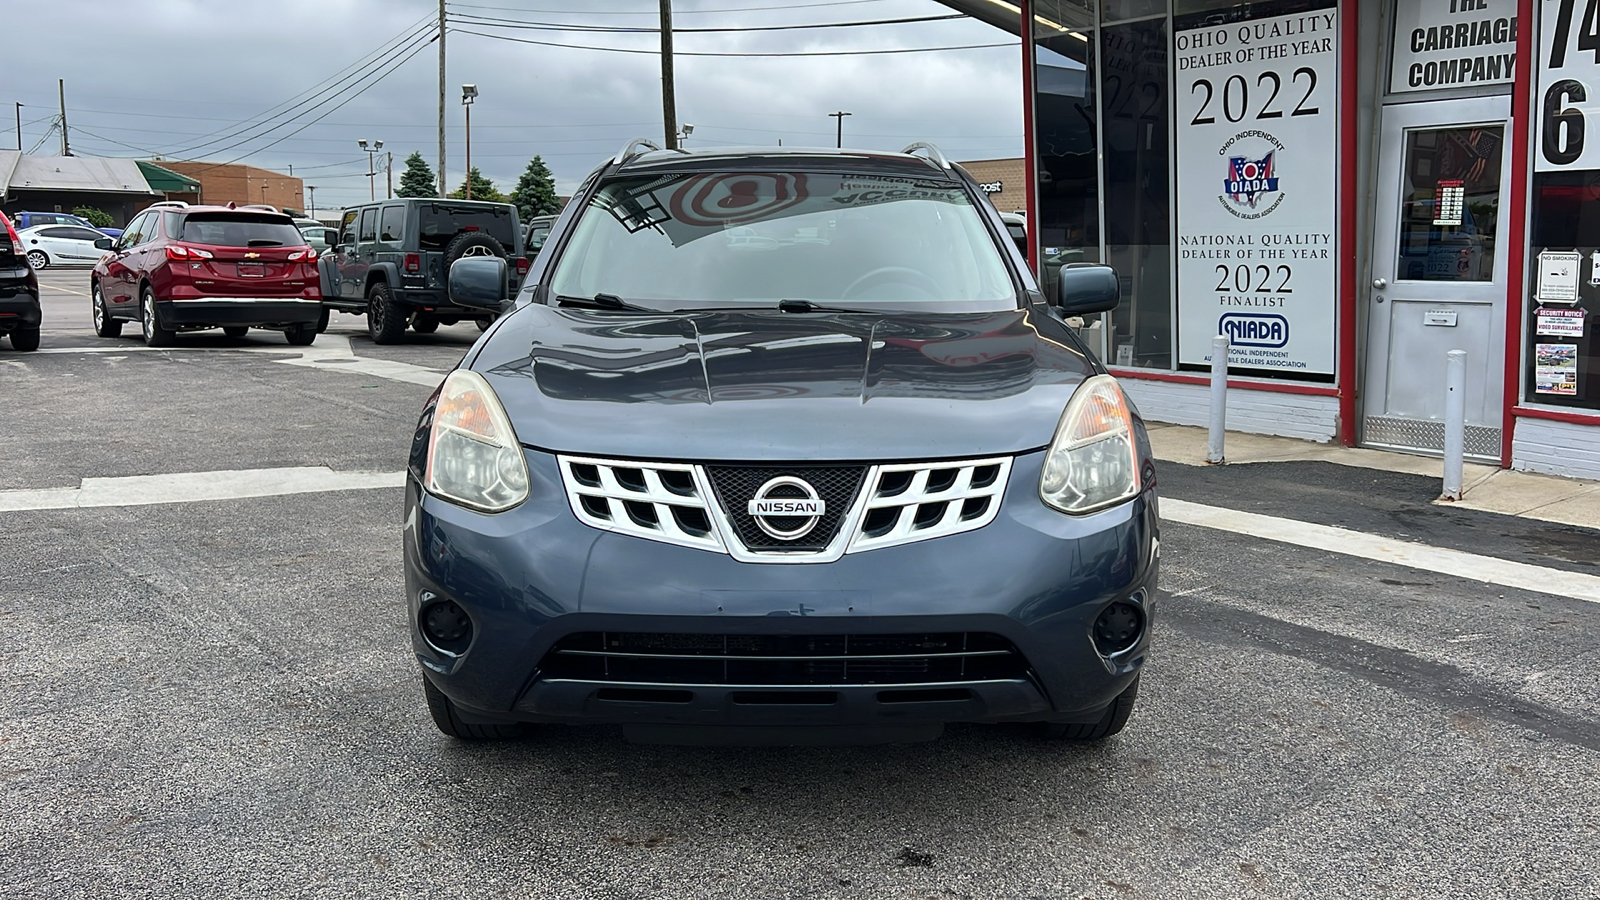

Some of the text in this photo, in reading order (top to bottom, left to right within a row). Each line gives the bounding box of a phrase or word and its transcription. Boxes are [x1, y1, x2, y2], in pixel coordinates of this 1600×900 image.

[1177, 13, 1335, 51] OHIO QUALITY
[1410, 17, 1518, 53] CARRIAGE
[1179, 37, 1333, 71] DEALER OF THE YEAR
[1408, 53, 1517, 88] COMPANY
[1190, 66, 1320, 126] 2022
[1541, 79, 1587, 165] 6
[1219, 129, 1285, 156] OHIO INDEPENDENT
[1230, 179, 1270, 193] OIADA
[1218, 191, 1286, 220] AUTOMOBILE DEALERS ASSOCIATION
[1180, 234, 1331, 246] NATIONAL QUALITY
[1182, 249, 1329, 259] DEALER OF THE YEAR
[1214, 264, 1293, 293] 2022
[1219, 296, 1286, 307] FINALIST
[1539, 309, 1564, 317] SECURITY
[1224, 320, 1282, 341] NIADA
[1240, 357, 1264, 365] DEALERS
[1265, 360, 1307, 368] ASSOCIATION
[1248, 350, 1289, 358] INDEPENDENT
[756, 502, 817, 512] NISSAN
